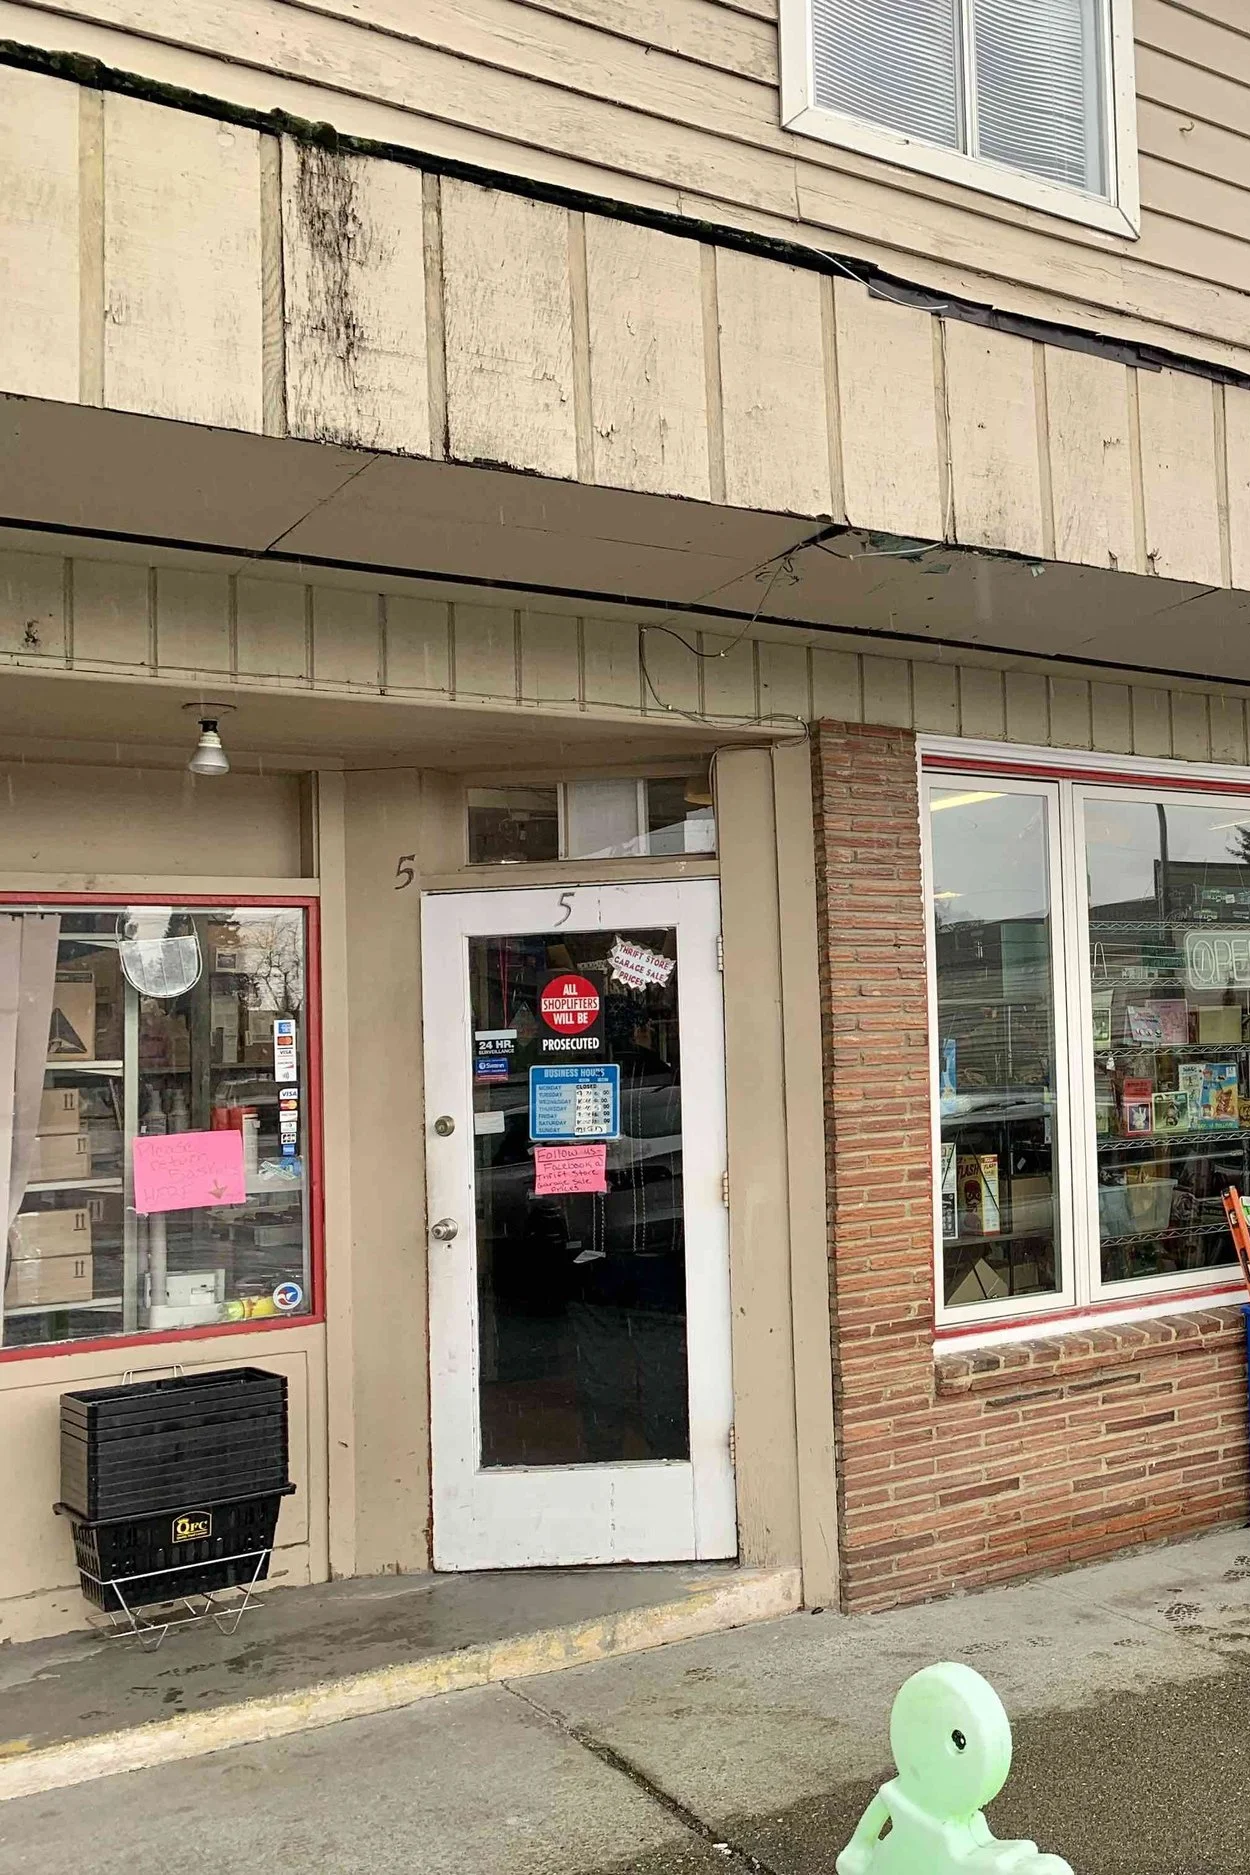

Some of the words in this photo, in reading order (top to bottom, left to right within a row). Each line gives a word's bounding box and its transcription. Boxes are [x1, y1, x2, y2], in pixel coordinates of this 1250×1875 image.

[395, 854, 416, 890] 5
[554, 892, 575, 927] 5
[620, 944, 645, 959] THRIFT
[645, 956, 669, 970] STORE
[619, 971, 645, 986] PRICES
[646, 969, 665, 981] SALE
[563, 984, 578, 996] ALL
[543, 998, 598, 1010] SHOPLIFTERS
[553, 1012, 574, 1025] WILL
[577, 1012, 588, 1024] BE
[479, 1041, 493, 1050] 24
[495, 1040, 515, 1049] HR.
[542, 1037, 599, 1051] PROSECUTED
[544, 1068, 579, 1078] BUSINESS
[537, 1148, 578, 1160] Follow
[543, 1162, 592, 1172] Facebook
